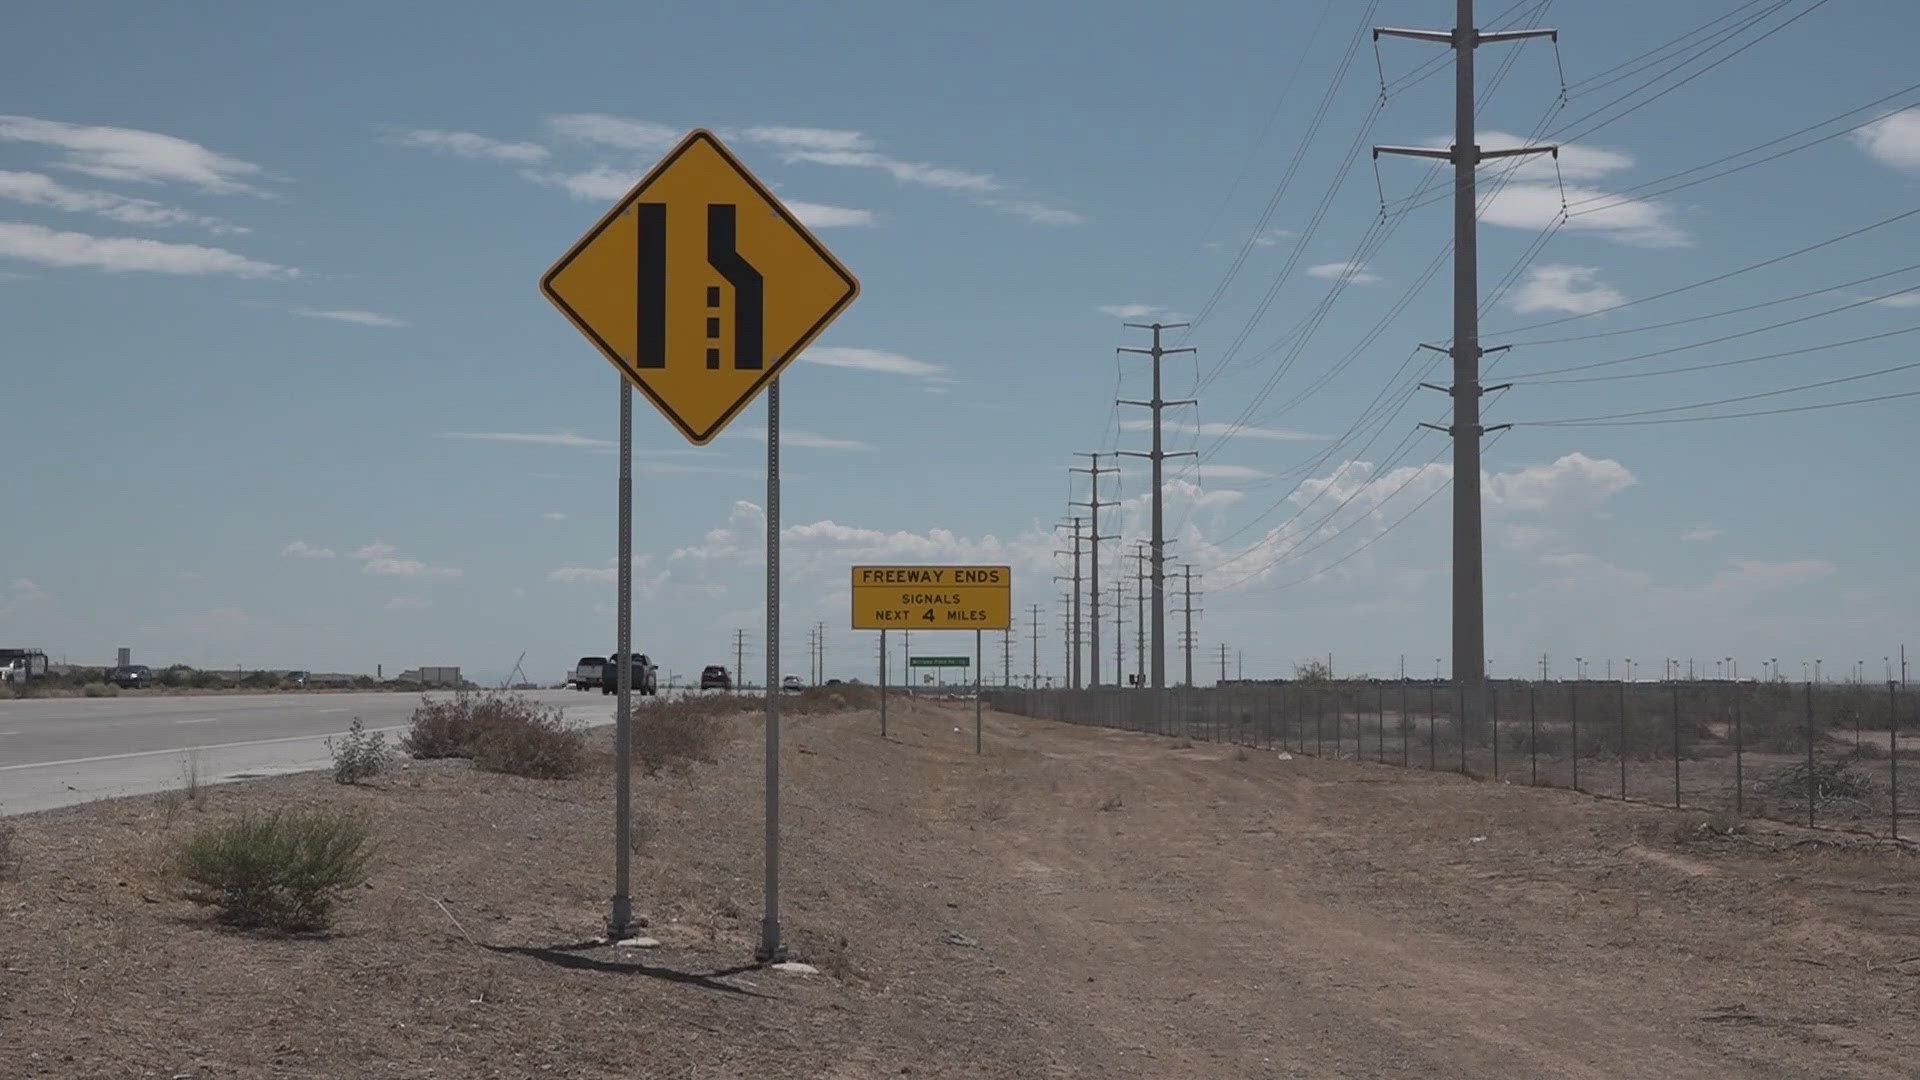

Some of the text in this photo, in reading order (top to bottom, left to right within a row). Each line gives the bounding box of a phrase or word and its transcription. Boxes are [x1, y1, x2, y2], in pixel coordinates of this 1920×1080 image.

[863, 570, 1000, 583] FREEWAY ENDS
[902, 594, 961, 604] SIGNALS
[875, 608, 987, 622] NEXT 4 MILES
